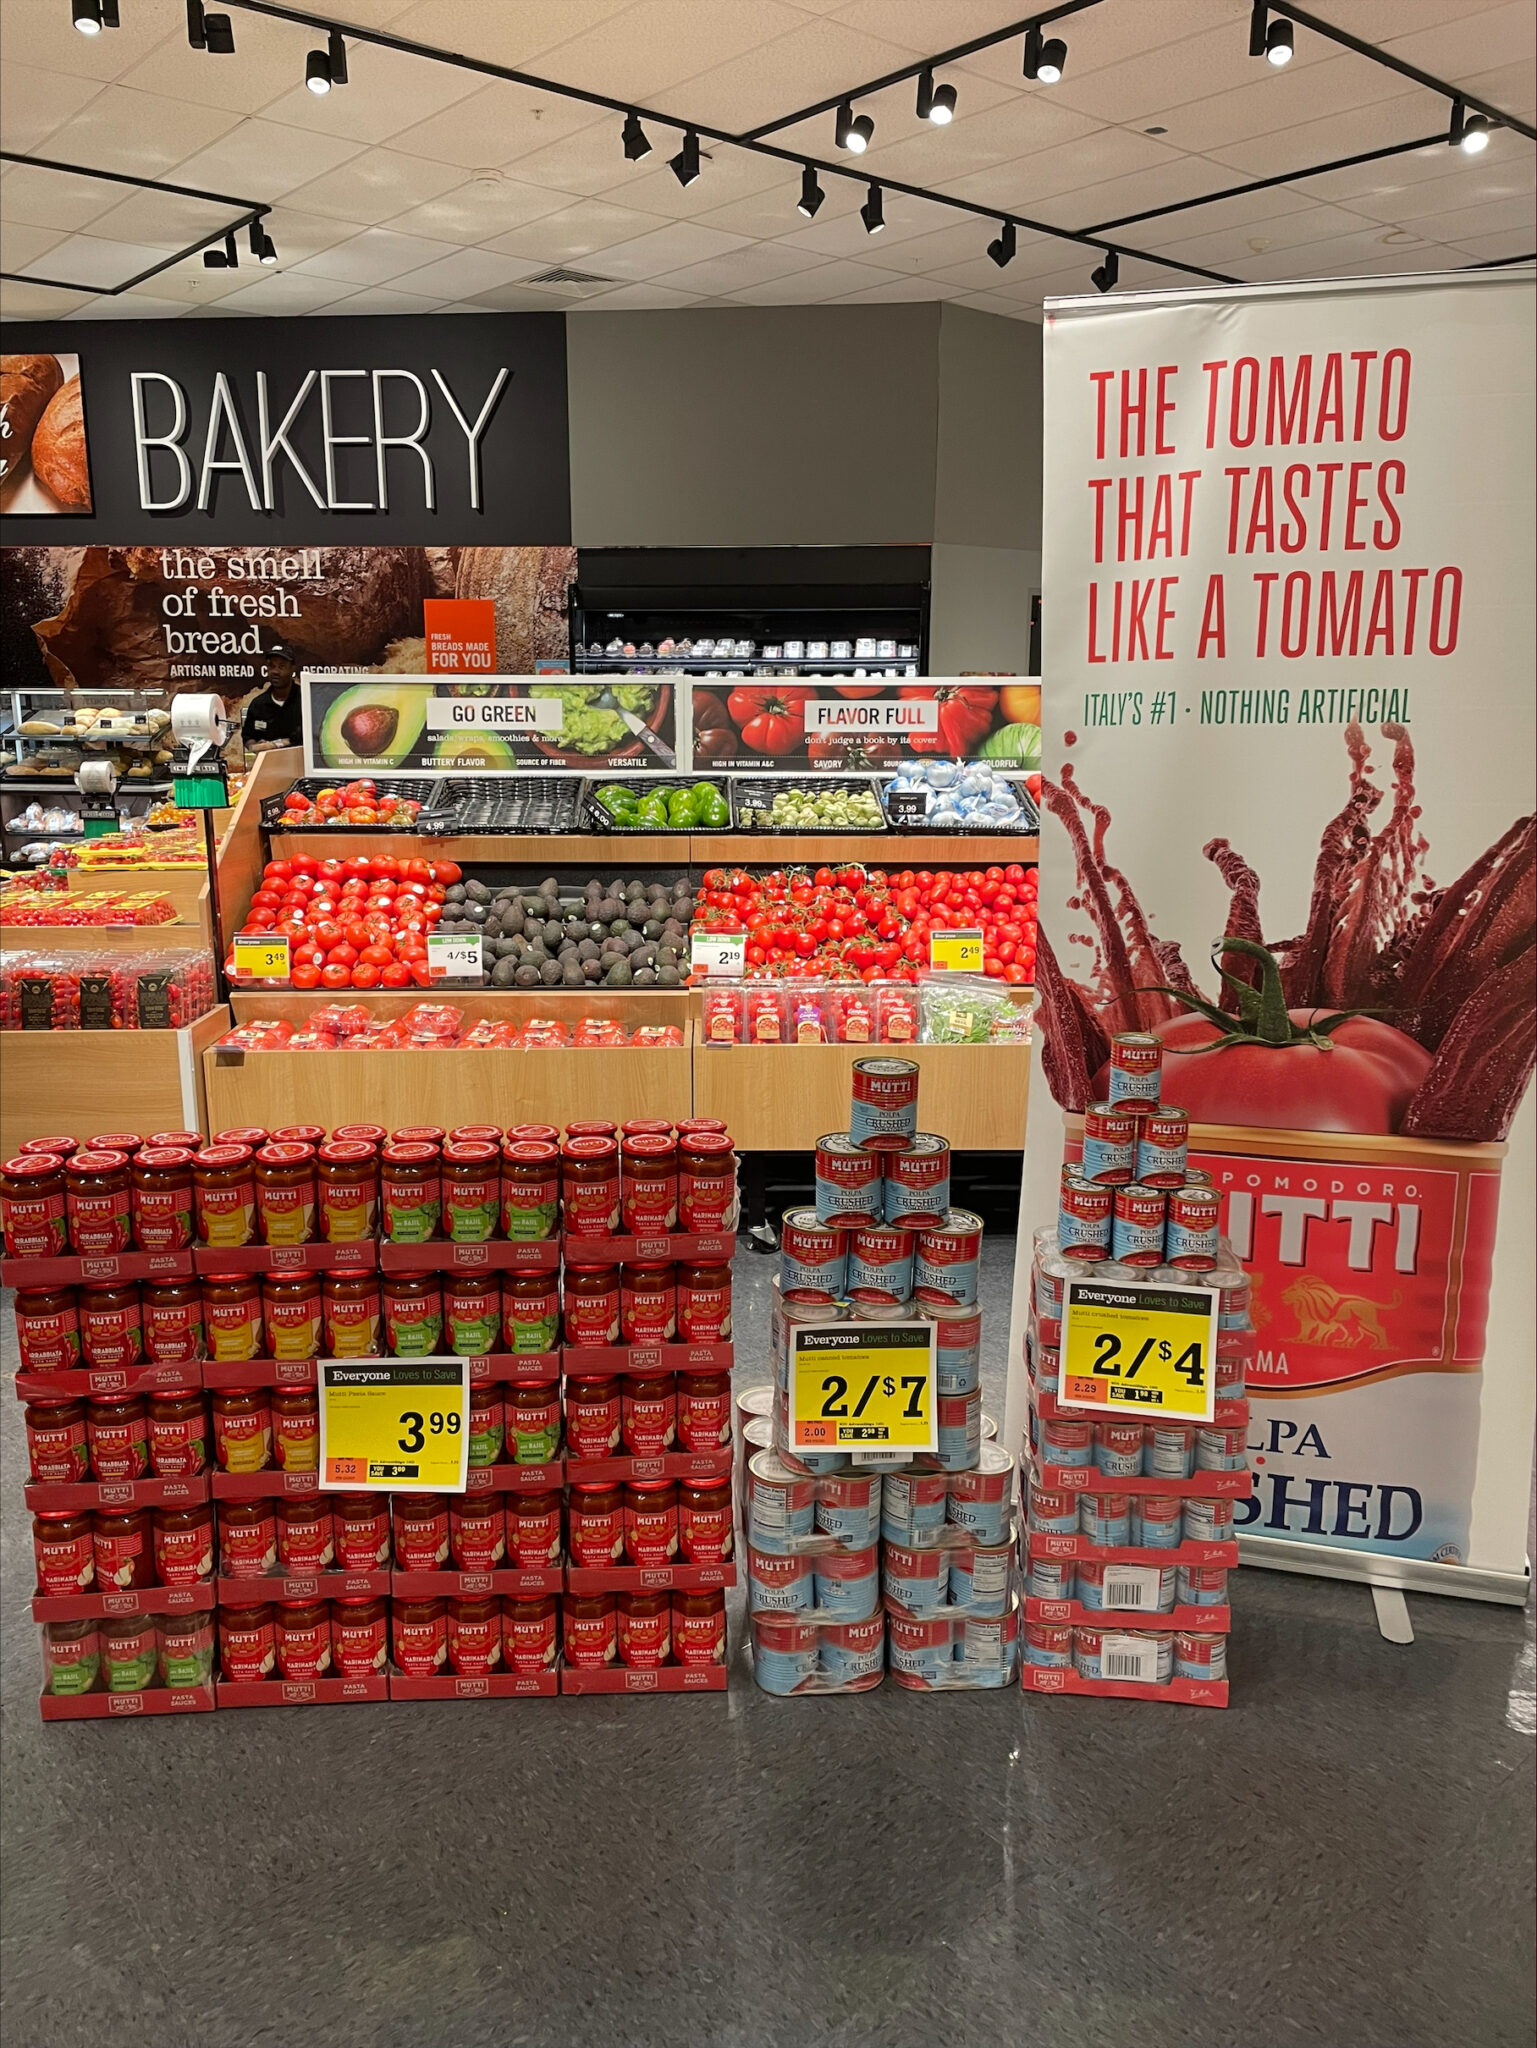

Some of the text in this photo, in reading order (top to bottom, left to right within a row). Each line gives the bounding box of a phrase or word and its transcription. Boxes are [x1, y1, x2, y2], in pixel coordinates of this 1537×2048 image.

[1089, 349, 1411, 459] THE TOMATO
[130, 368, 509, 511] BAKERY
[1088, 460, 1405, 563] THAT TASTES
[160, 549, 325, 580] the smell
[162, 586, 302, 617] of fresh
[1088, 567, 1463, 663] LIKE A TOMATO
[163, 624, 263, 654] bread
[432, 653, 491, 667] FOR YOU
[170, 665, 216, 677] ARTISAN
[219, 665, 254, 677] BREAD
[1084, 688, 1411, 726] ITALY'S #1 NOTHING ARTIFICIAL
[453, 706, 536, 722] GO GREEN
[818, 708, 925, 724] FLAVOR FULL
[488, 734, 529, 742] smoothies
[828, 737, 853, 747] judge
[864, 736, 885, 744] book
[887, 736, 898, 747] by
[900, 736, 911, 744] its
[422, 758, 485, 766] BUTTERY FLAVOR
[814, 760, 842, 768] SAVORY
[898, 805, 917, 813] 3.99
[1122, 1050, 1157, 1060] MUTTI
[871, 1080, 911, 1092] MUTTI
[1117, 1082, 1159, 1091] CRUSHED
[866, 1118, 910, 1127] CRUSHED
[832, 1160, 872, 1171] MUTTI
[636, 1183, 666, 1192] MUTTI
[693, 1181, 723, 1190] MUTTI
[265, 1192, 296, 1200] MUTTI
[328, 1188, 360, 1197] MUTTI
[454, 1187, 484, 1196] MUTTI
[77, 1201, 111, 1210] MUTTI
[829, 1196, 873, 1206] CRUSHED
[896, 1196, 941, 1206] CRUSHED
[1074, 1195, 1108, 1206] MUTTI
[792, 1234, 833, 1249] MUTTI
[788, 1271, 832, 1283] CRUSHED
[852, 1271, 896, 1283] CRUSHED
[454, 1300, 484, 1310] MUTTI
[1078, 1289, 1205, 1310] Everyone Loves to Save
[25, 1319, 59, 1329] MUTTI
[804, 1333, 924, 1346] Everyone Loves to Save
[1093, 1333, 1205, 1386] 2/$4
[333, 1369, 457, 1382] Everyone Loves to Save
[1074, 1383, 1096, 1393] 2.29
[821, 1376, 927, 1418] 2/$7
[690, 1401, 720, 1409] MUTTI
[804, 1428, 826, 1436] 2.00
[335, 1465, 356, 1473] 5.32
[1233, 1471, 1423, 1541] SHED
[518, 1519, 548, 1529] MUTTI
[755, 1558, 794, 1571] MUTTI
[458, 1625, 488, 1635] MUTTI
